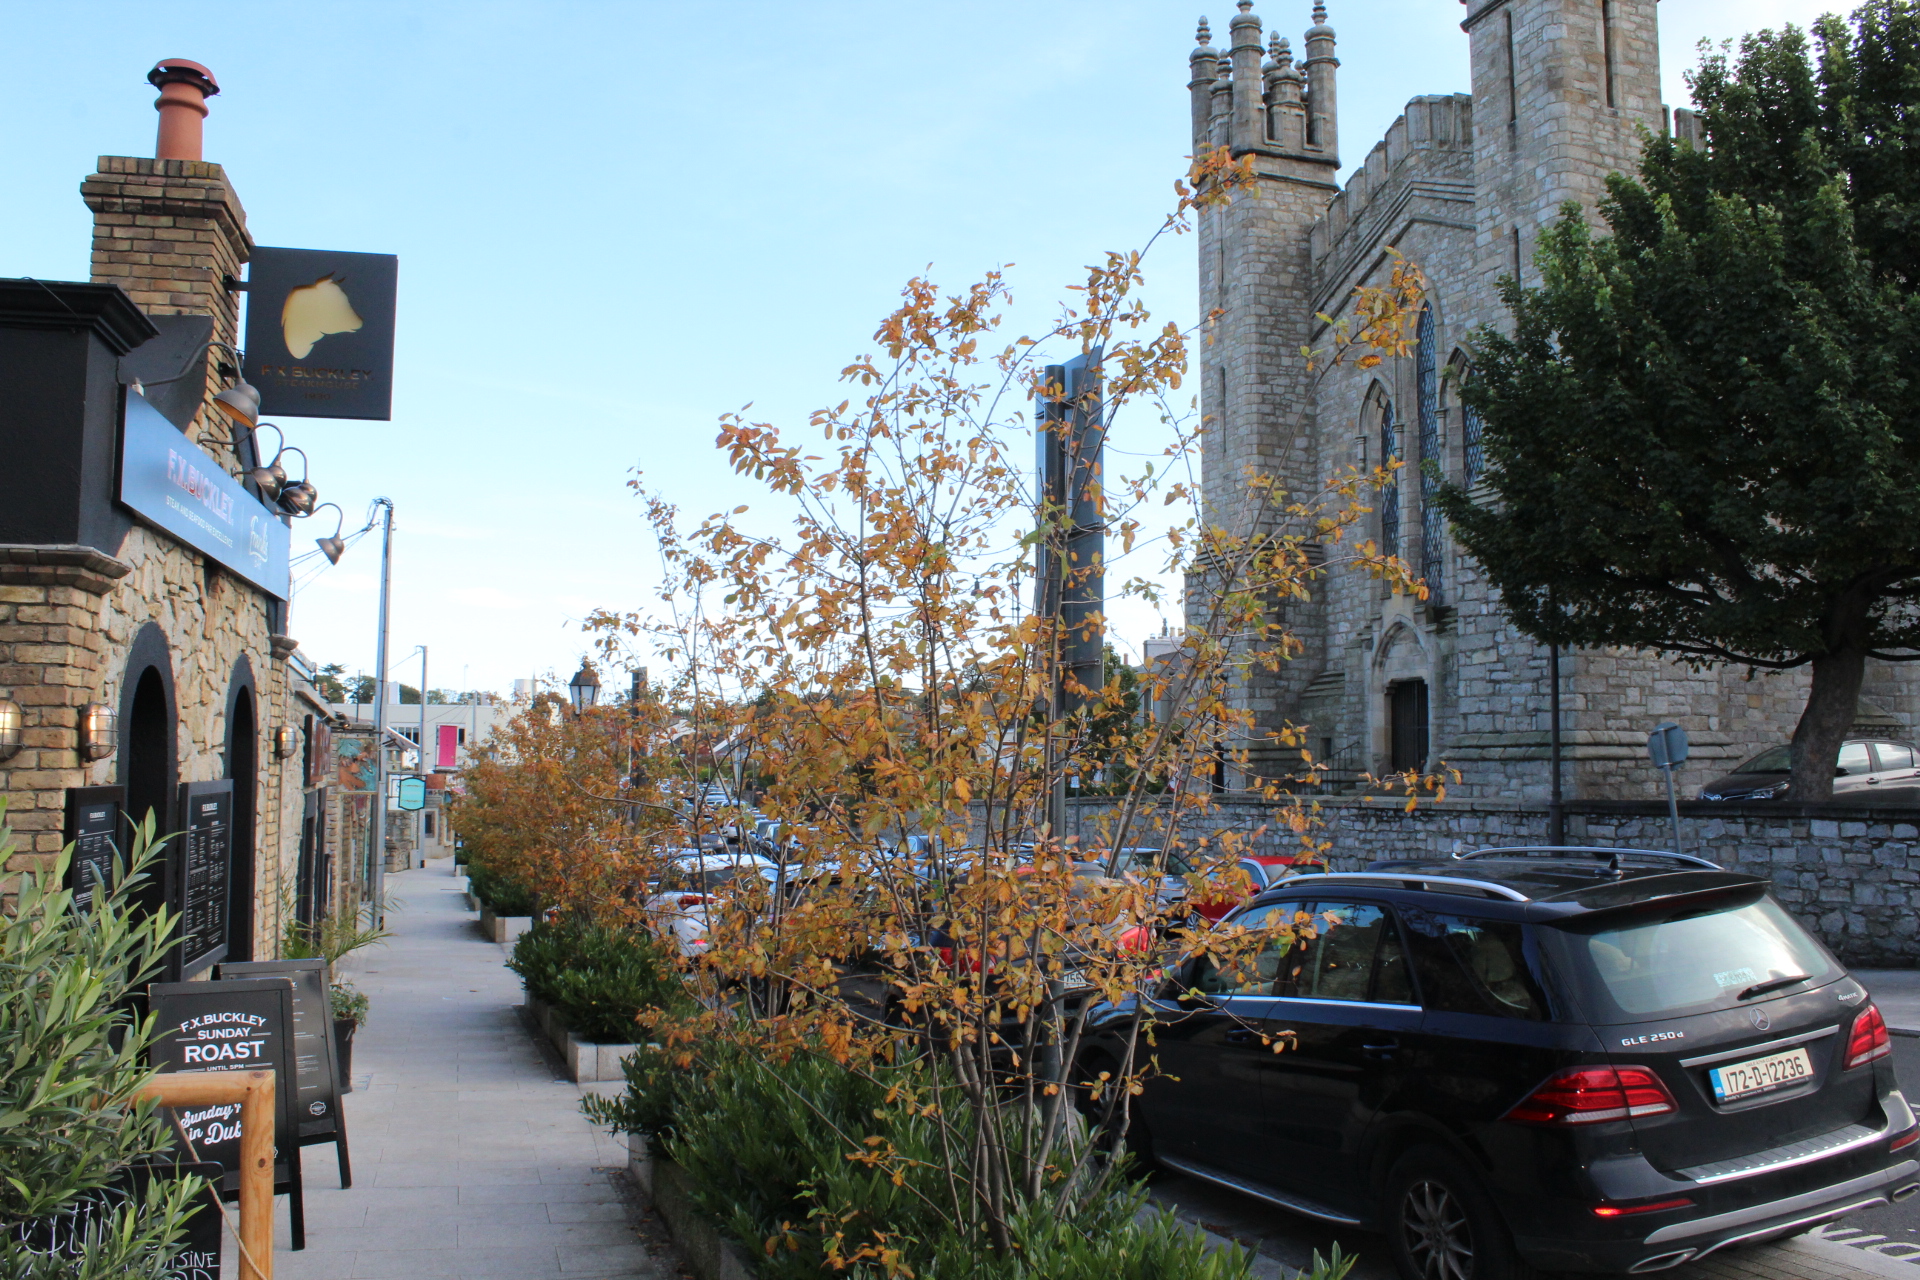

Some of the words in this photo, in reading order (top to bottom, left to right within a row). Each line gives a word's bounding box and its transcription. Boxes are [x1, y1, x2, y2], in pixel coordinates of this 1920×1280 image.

[180, 1012, 267, 1033] F.X.BUCKLEY
[197, 1027, 252, 1040] SUNDAY
[1621, 1035, 1648, 1047] GLE
[184, 1040, 265, 1063] ROAST
[207, 1064, 228, 1072] UNTIL
[1726, 1056, 1804, 1092] 172-D-12236
[180, 1104, 234, 1129] Sunday
[189, 1127, 203, 1141] in
